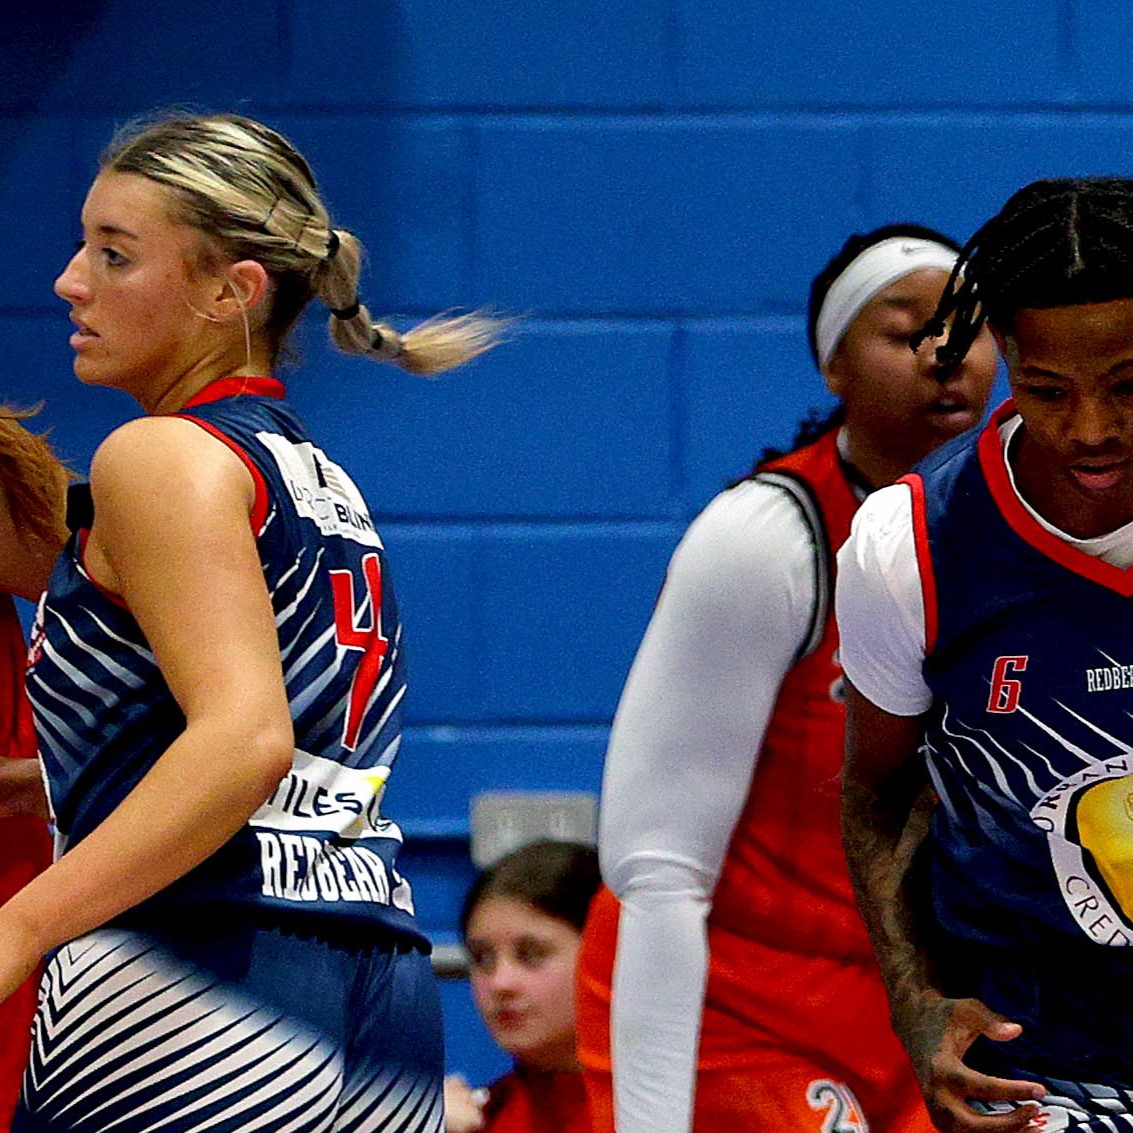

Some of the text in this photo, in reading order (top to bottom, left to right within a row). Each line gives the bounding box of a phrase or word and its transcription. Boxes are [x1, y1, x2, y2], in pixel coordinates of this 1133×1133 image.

[329, 552, 388, 752] 4
[986, 655, 1028, 714] 6
[267, 773, 362, 818] ILES
